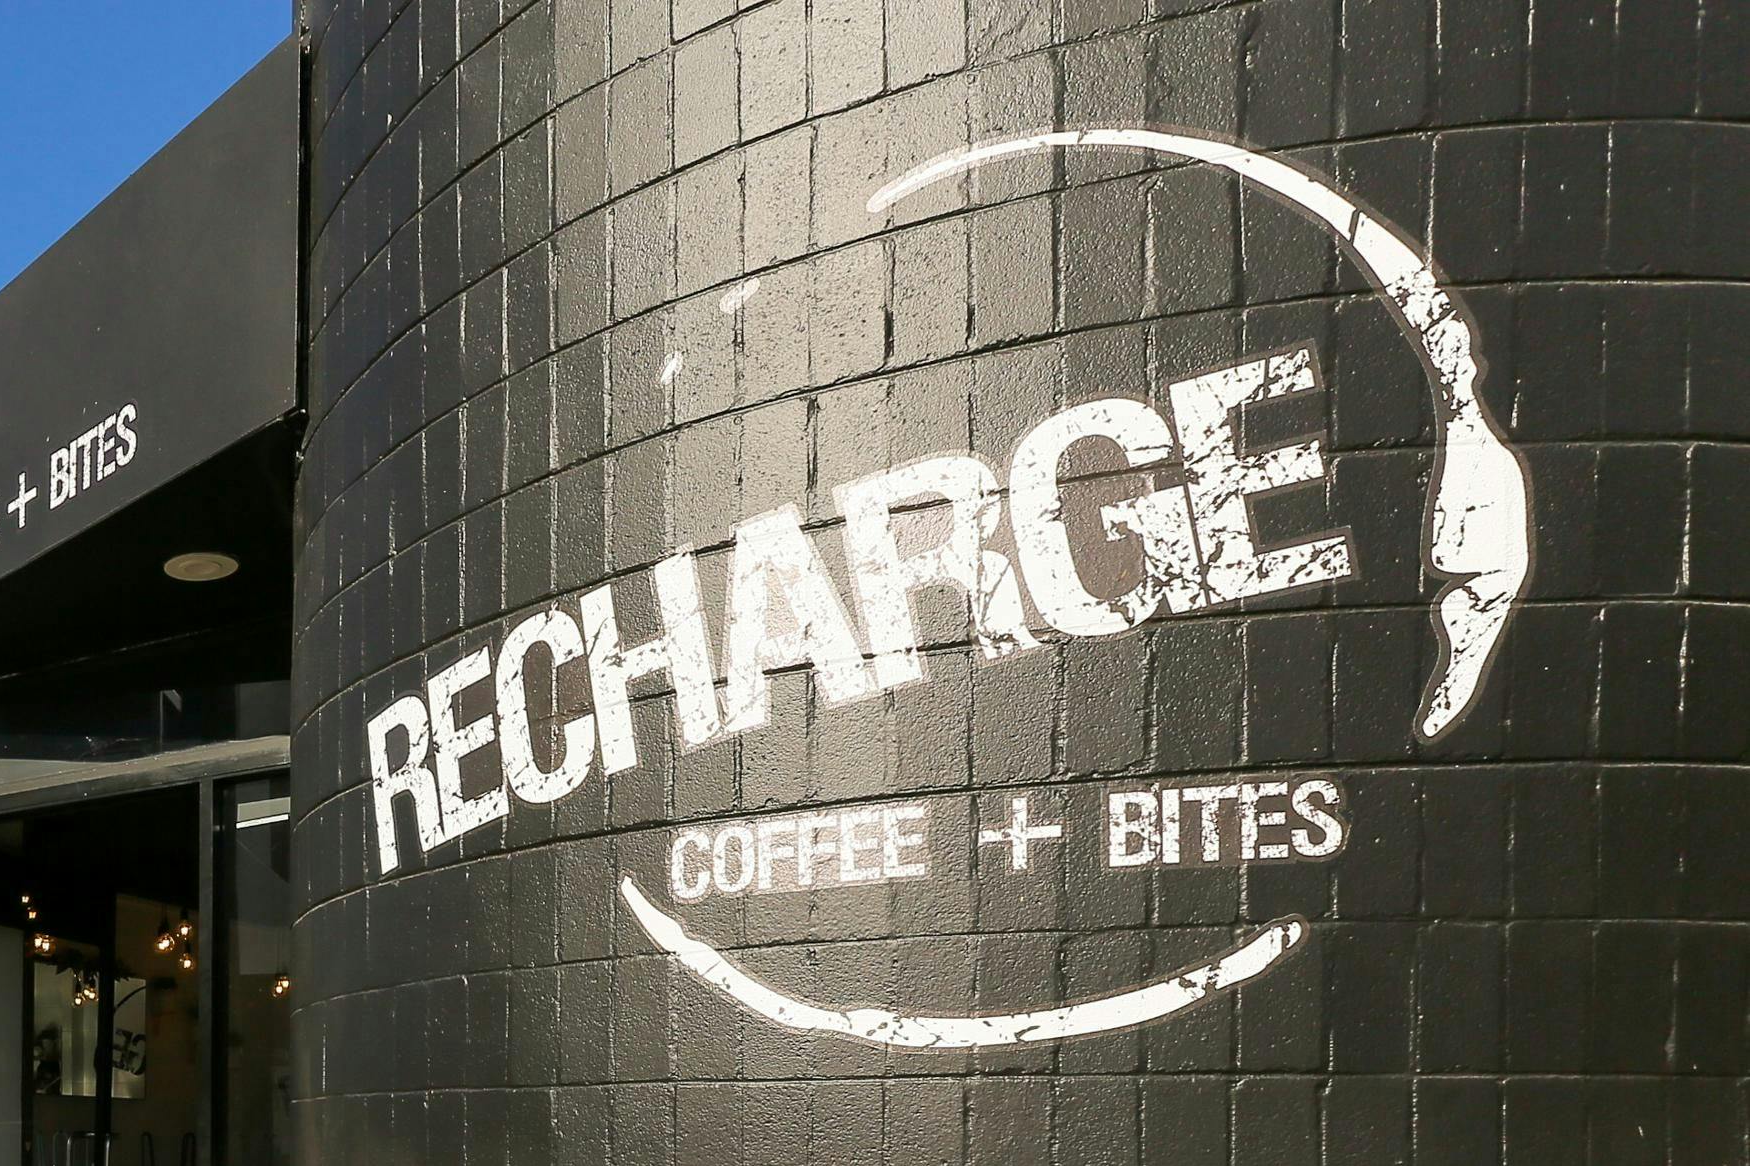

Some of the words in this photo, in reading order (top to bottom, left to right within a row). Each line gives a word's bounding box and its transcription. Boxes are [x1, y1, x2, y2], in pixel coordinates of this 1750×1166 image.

[50, 403, 138, 510] BITES
[365, 347, 1354, 876] RECHARGE
[670, 803, 928, 902] COFFEE
[1107, 779, 1345, 869] BITES
